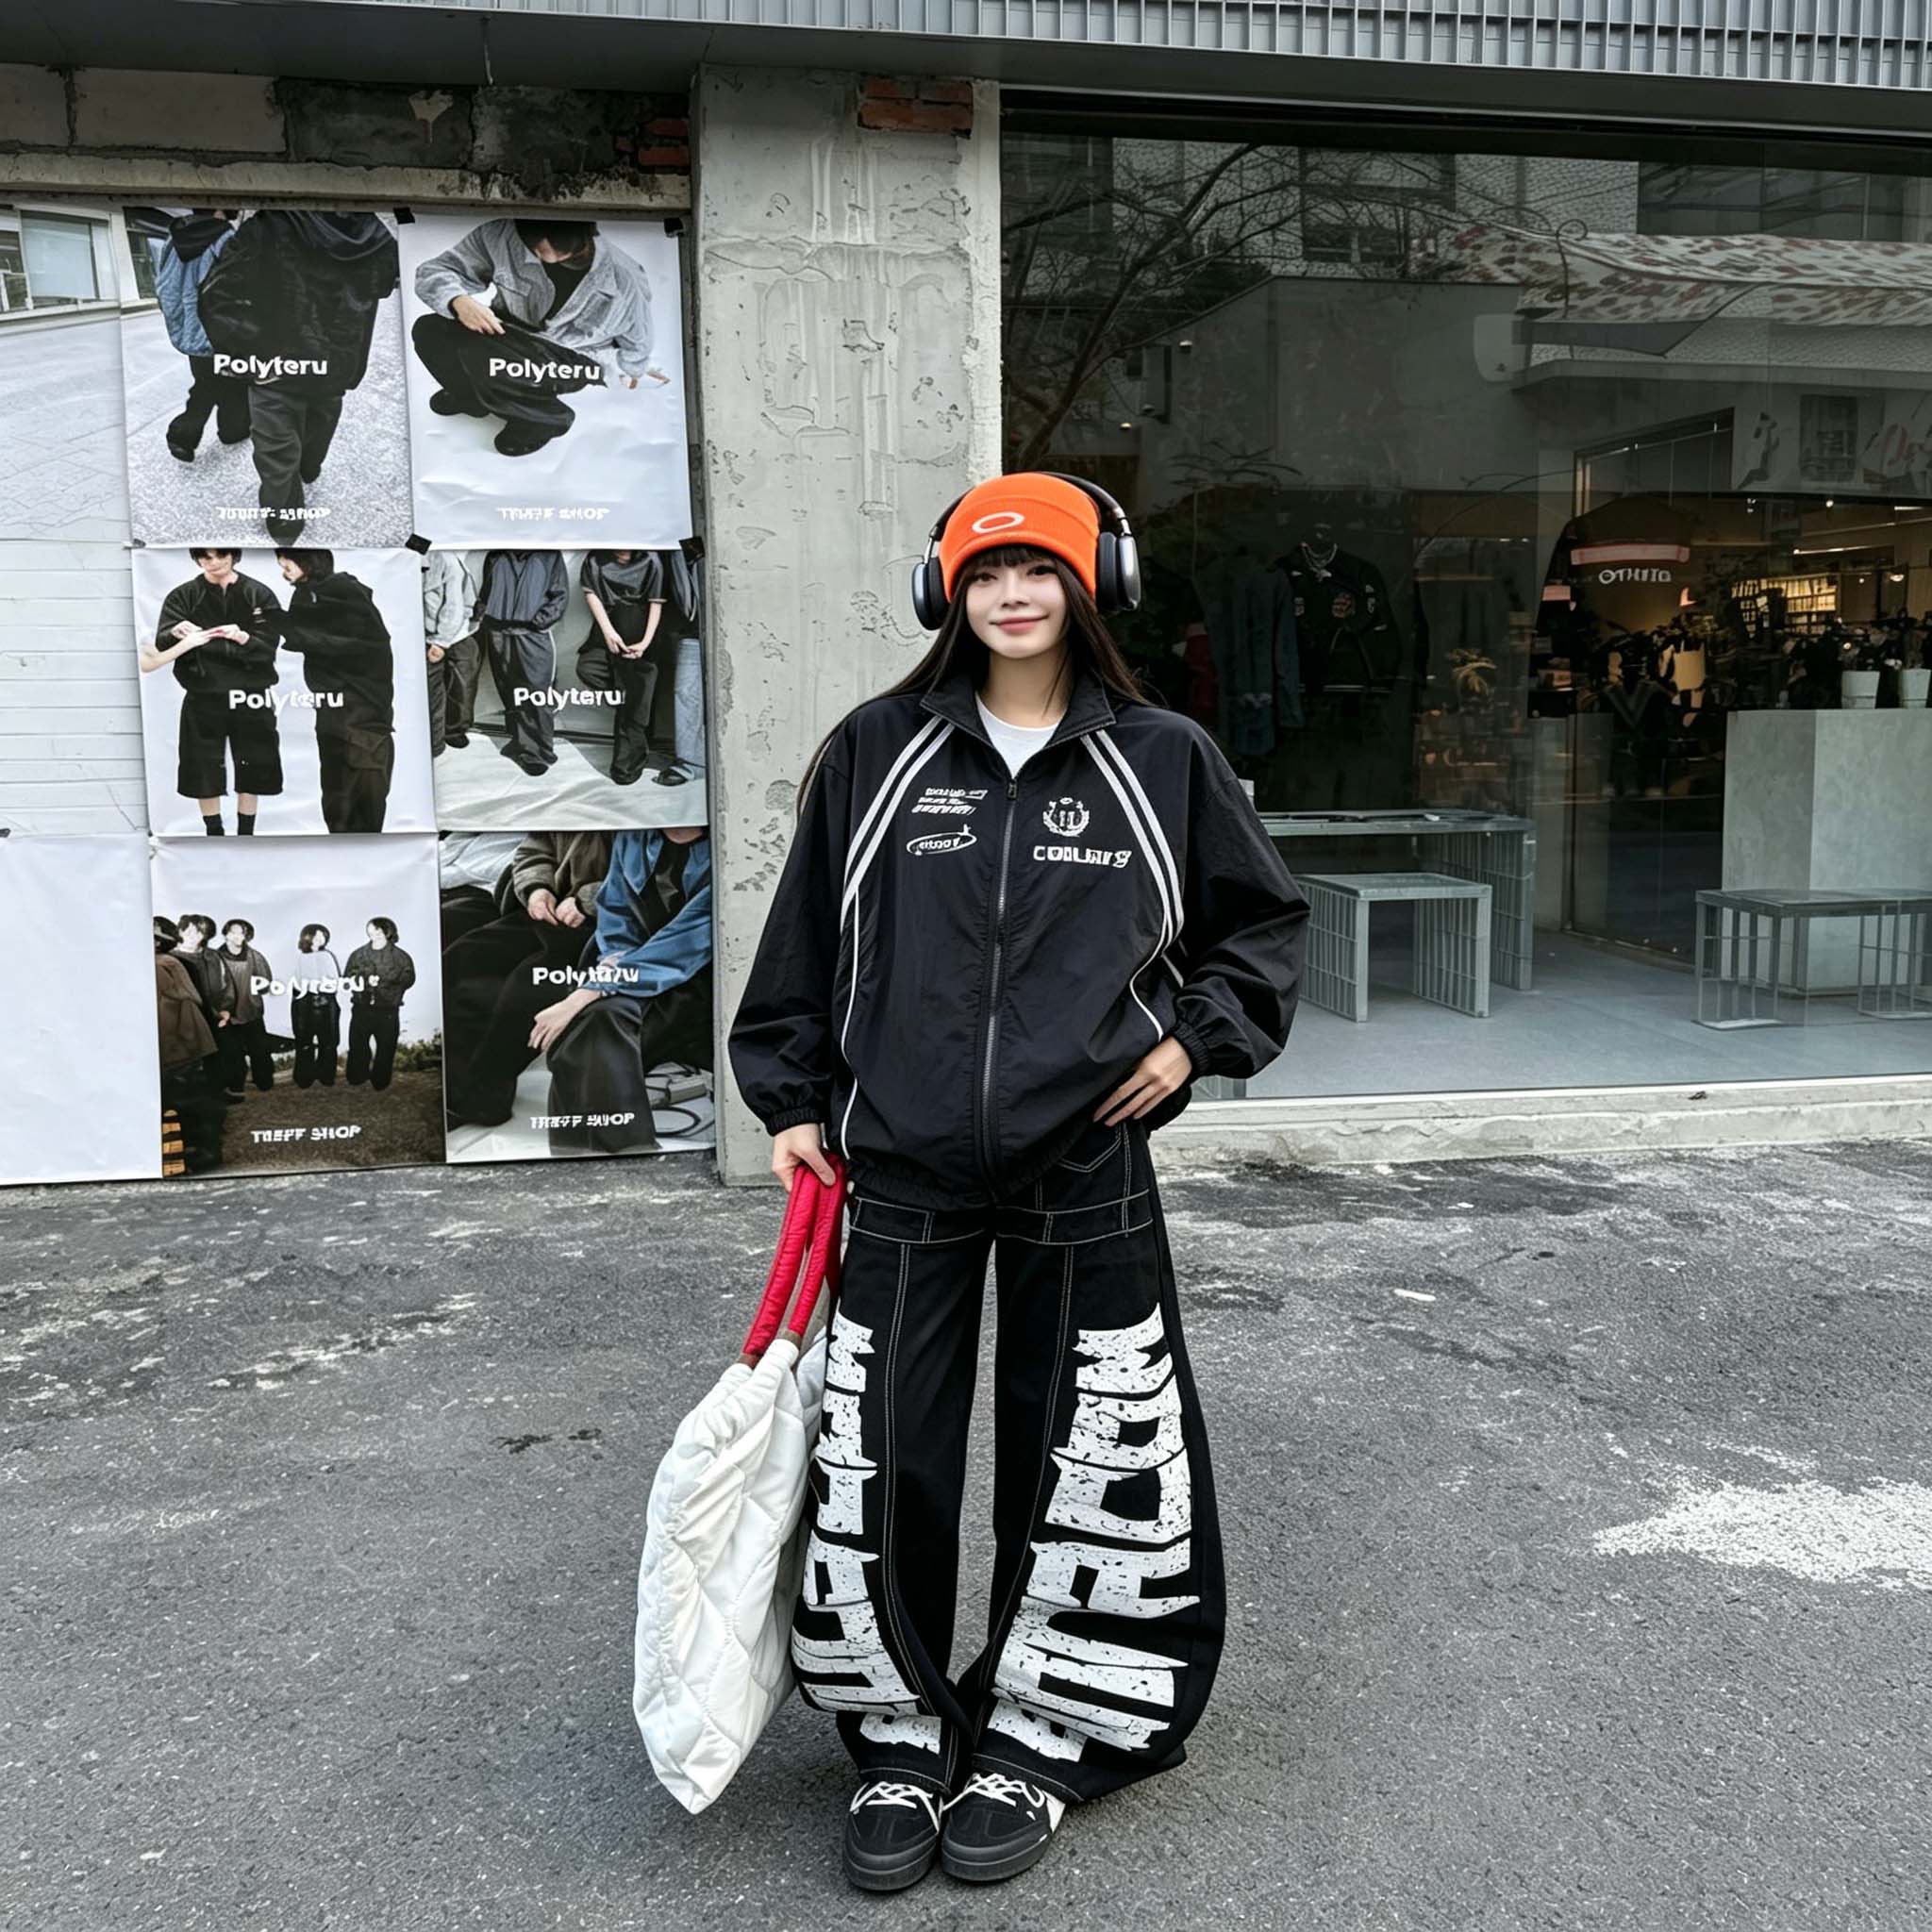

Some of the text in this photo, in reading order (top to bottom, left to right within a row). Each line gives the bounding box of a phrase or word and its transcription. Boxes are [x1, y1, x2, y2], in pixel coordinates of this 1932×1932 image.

[213, 353, 328, 379] Polyteru
[489, 358, 601, 383] Polyteru
[513, 686, 624, 713] Polyteru
